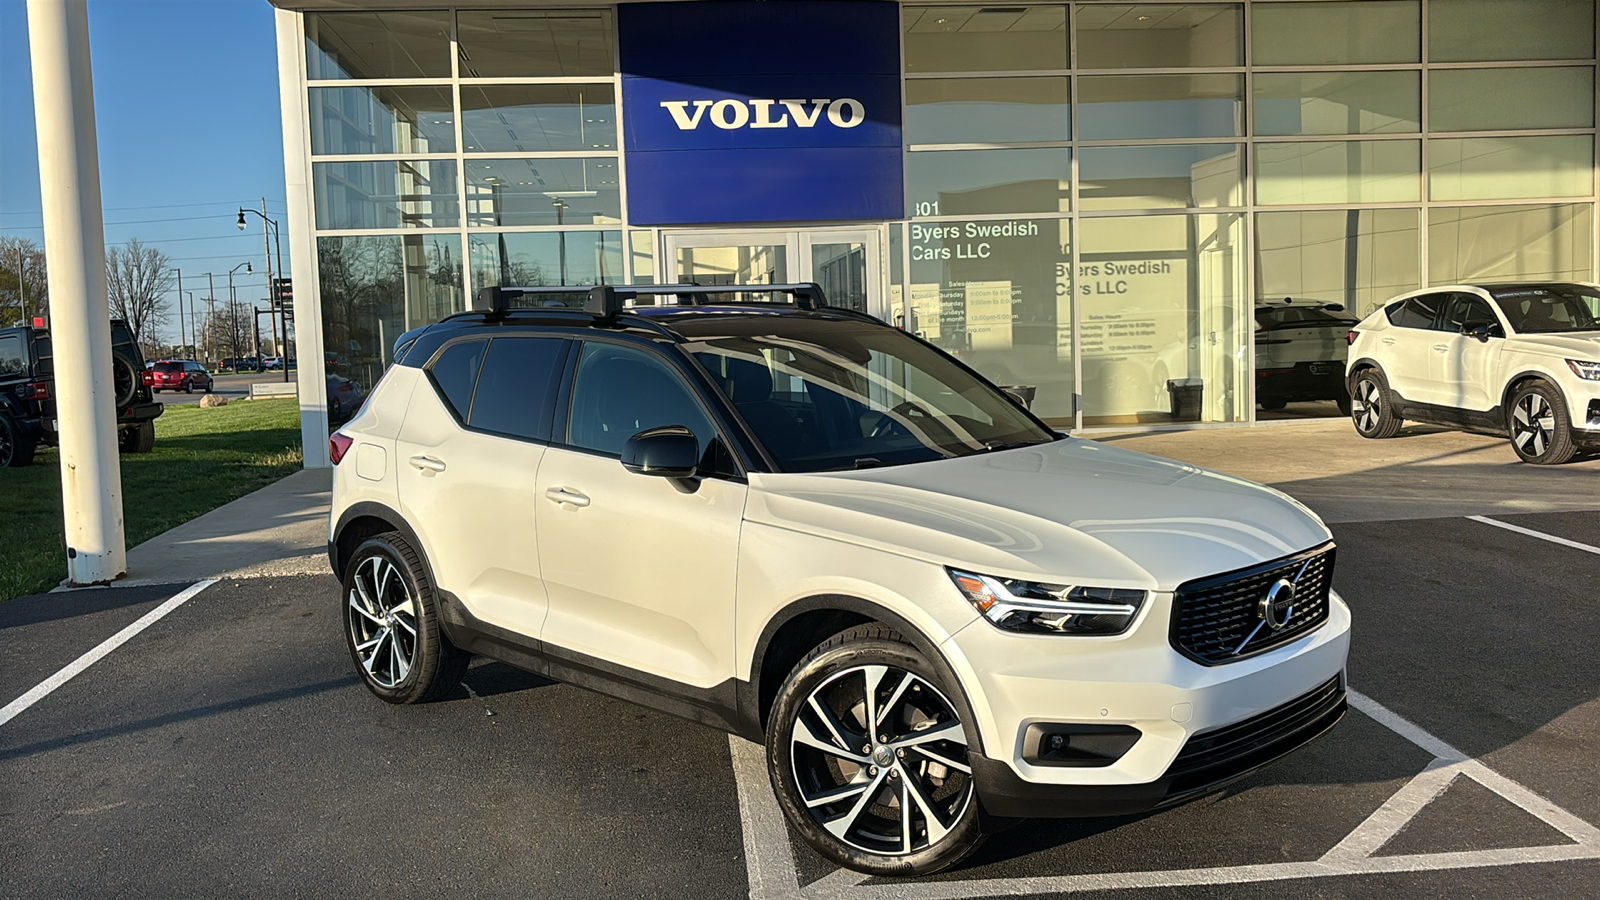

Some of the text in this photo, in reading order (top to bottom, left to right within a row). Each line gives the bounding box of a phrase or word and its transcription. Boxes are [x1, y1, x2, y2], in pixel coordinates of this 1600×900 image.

[660, 98, 865, 130] VOLVO
[912, 221, 1038, 243] Byers Swedish
[912, 242, 991, 261] Cars LLC
[1104, 261, 1170, 276] Swedish
[1096, 281, 1127, 295] LLC
